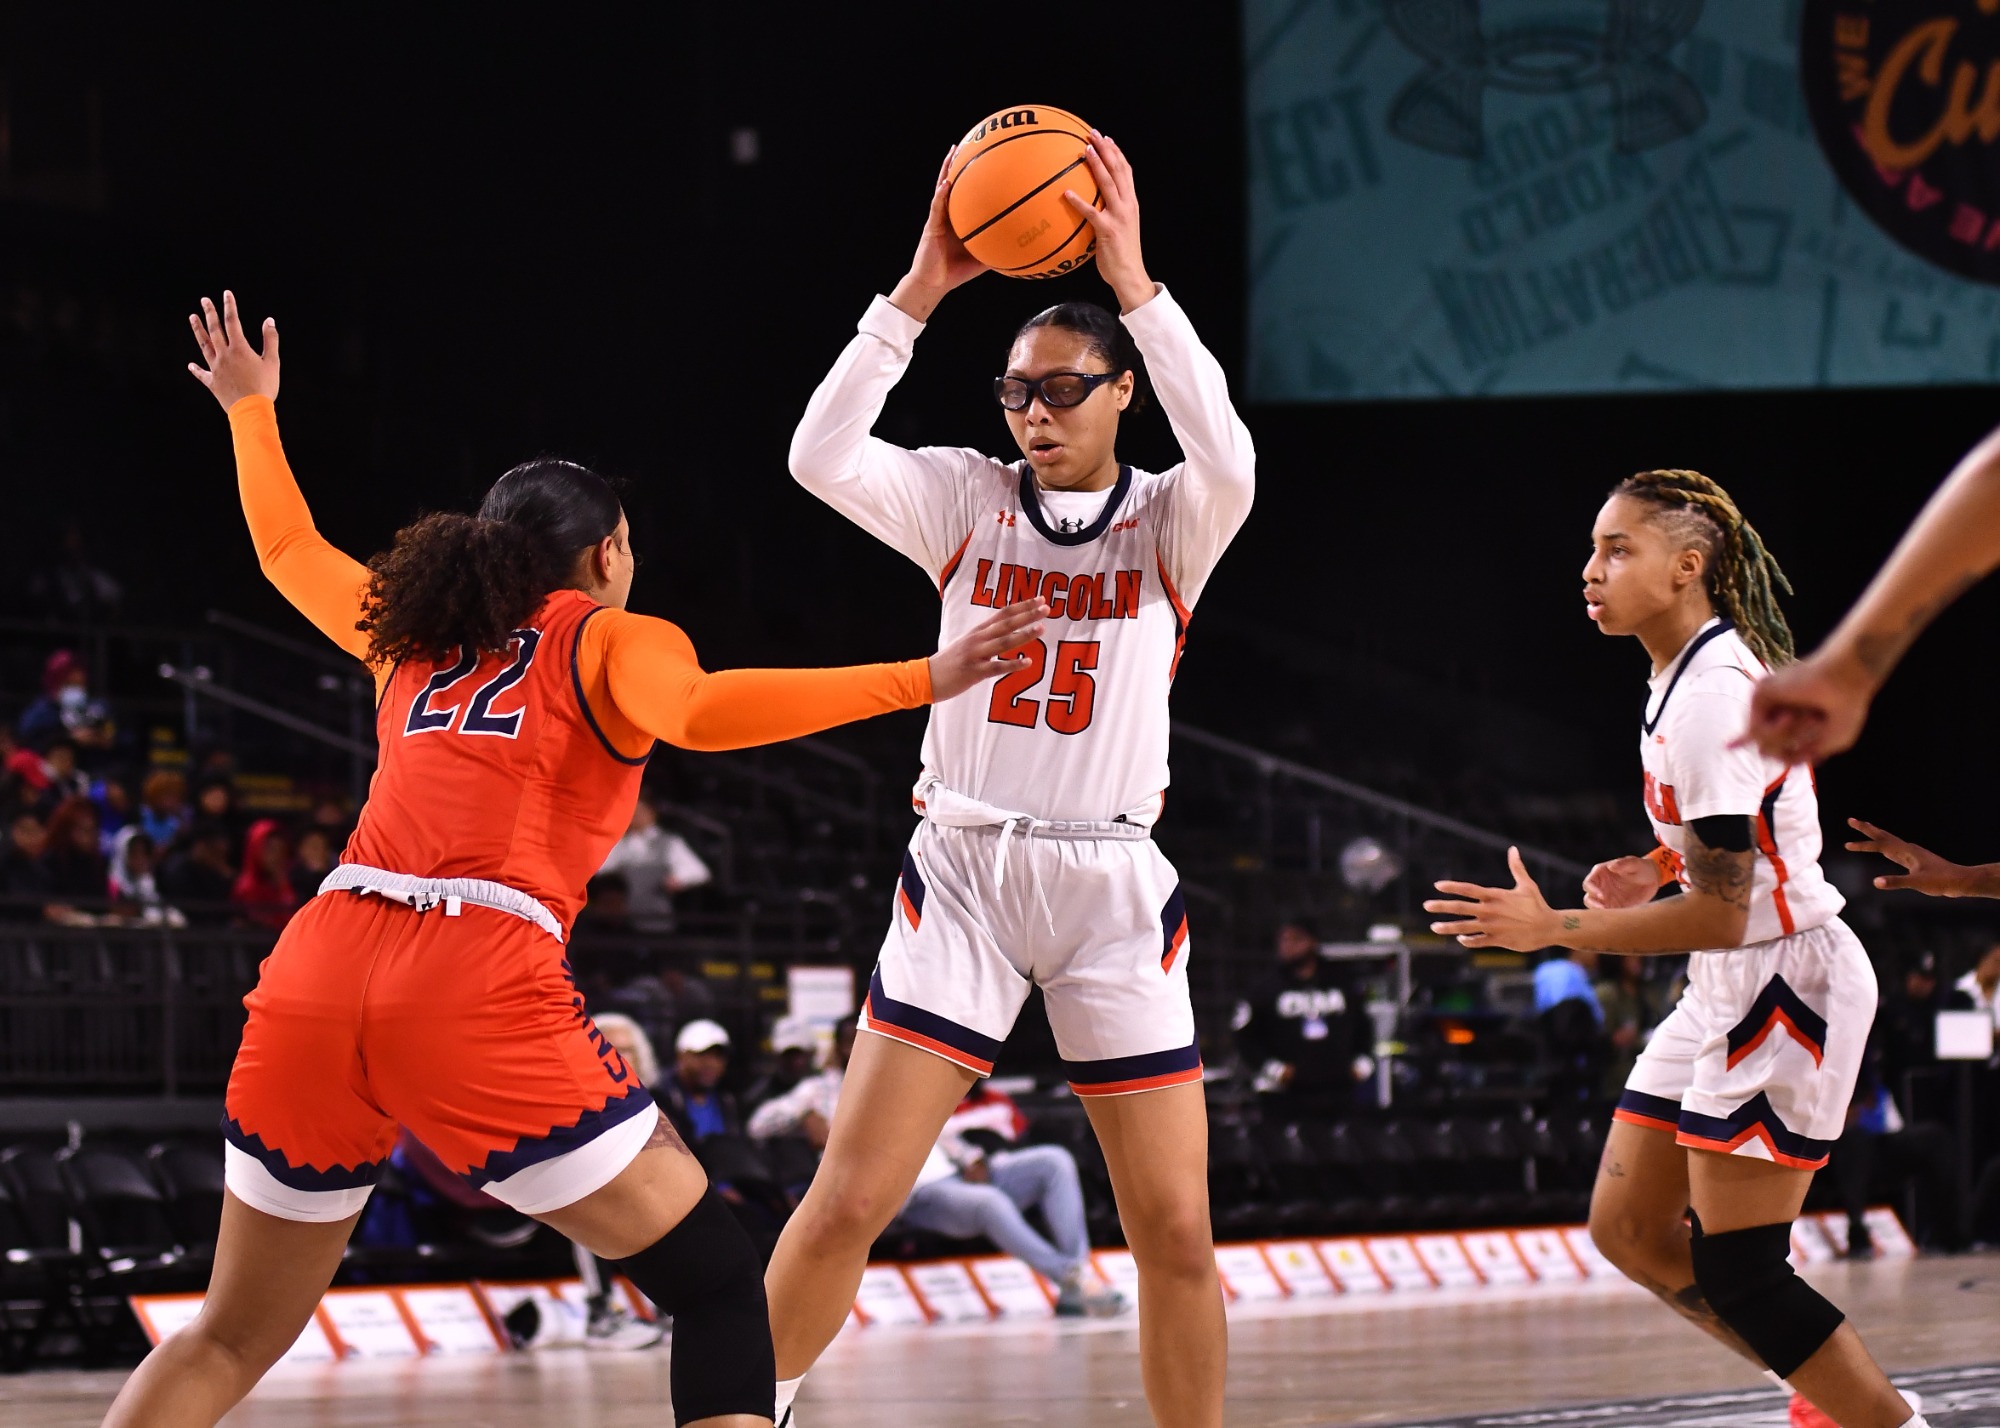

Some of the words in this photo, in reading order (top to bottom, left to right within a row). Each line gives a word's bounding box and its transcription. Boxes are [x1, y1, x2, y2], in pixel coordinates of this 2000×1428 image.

[970, 557, 1142, 621] LINCOLN
[403, 627, 544, 740] 22
[988, 637, 1100, 735] 25
